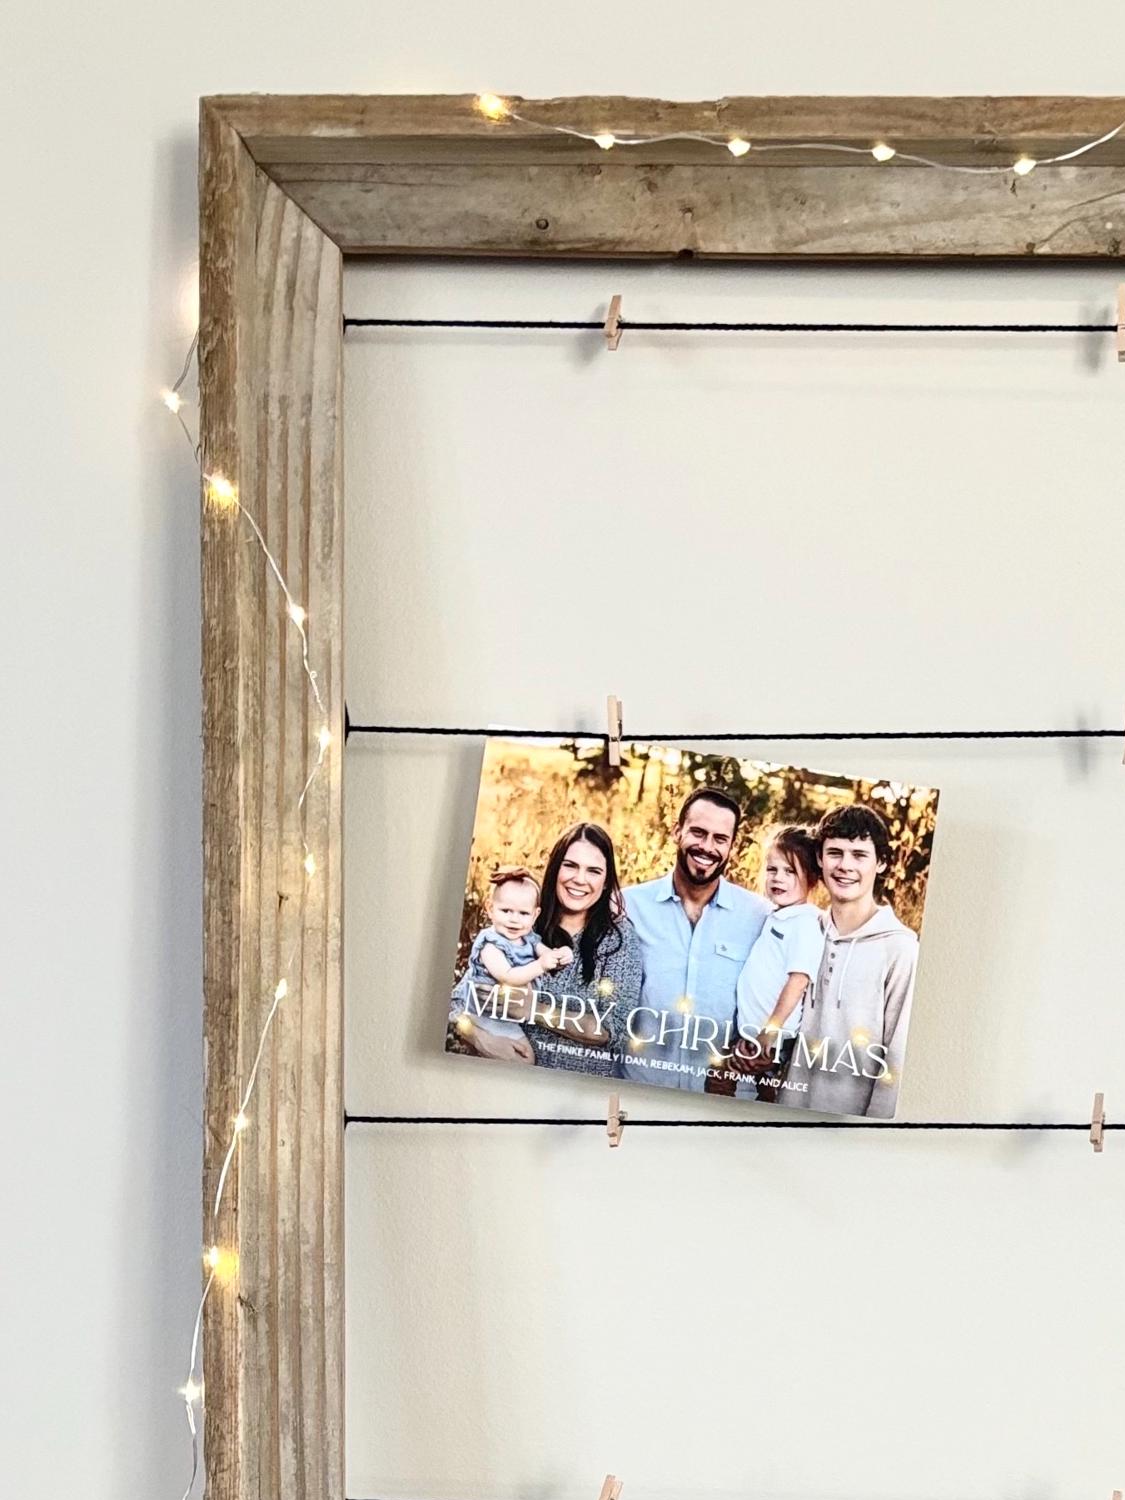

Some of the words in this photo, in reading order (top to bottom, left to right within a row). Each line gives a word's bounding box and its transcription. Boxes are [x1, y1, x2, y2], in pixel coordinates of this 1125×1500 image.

[463, 981, 615, 1036] MERRY
[626, 1006, 890, 1080] CHRISTMAS
[537, 1041, 556, 1053] THE
[556, 1046, 584, 1057] FINKE
[585, 1049, 619, 1062] FAMILY
[625, 1055, 648, 1068] DAN,
[650, 1059, 695, 1074] REBEKAH,
[696, 1067, 722, 1080] JACK,
[724, 1071, 757, 1084] FRANK,
[759, 1077, 782, 1089] AND
[781, 1081, 809, 1092] ALICE
